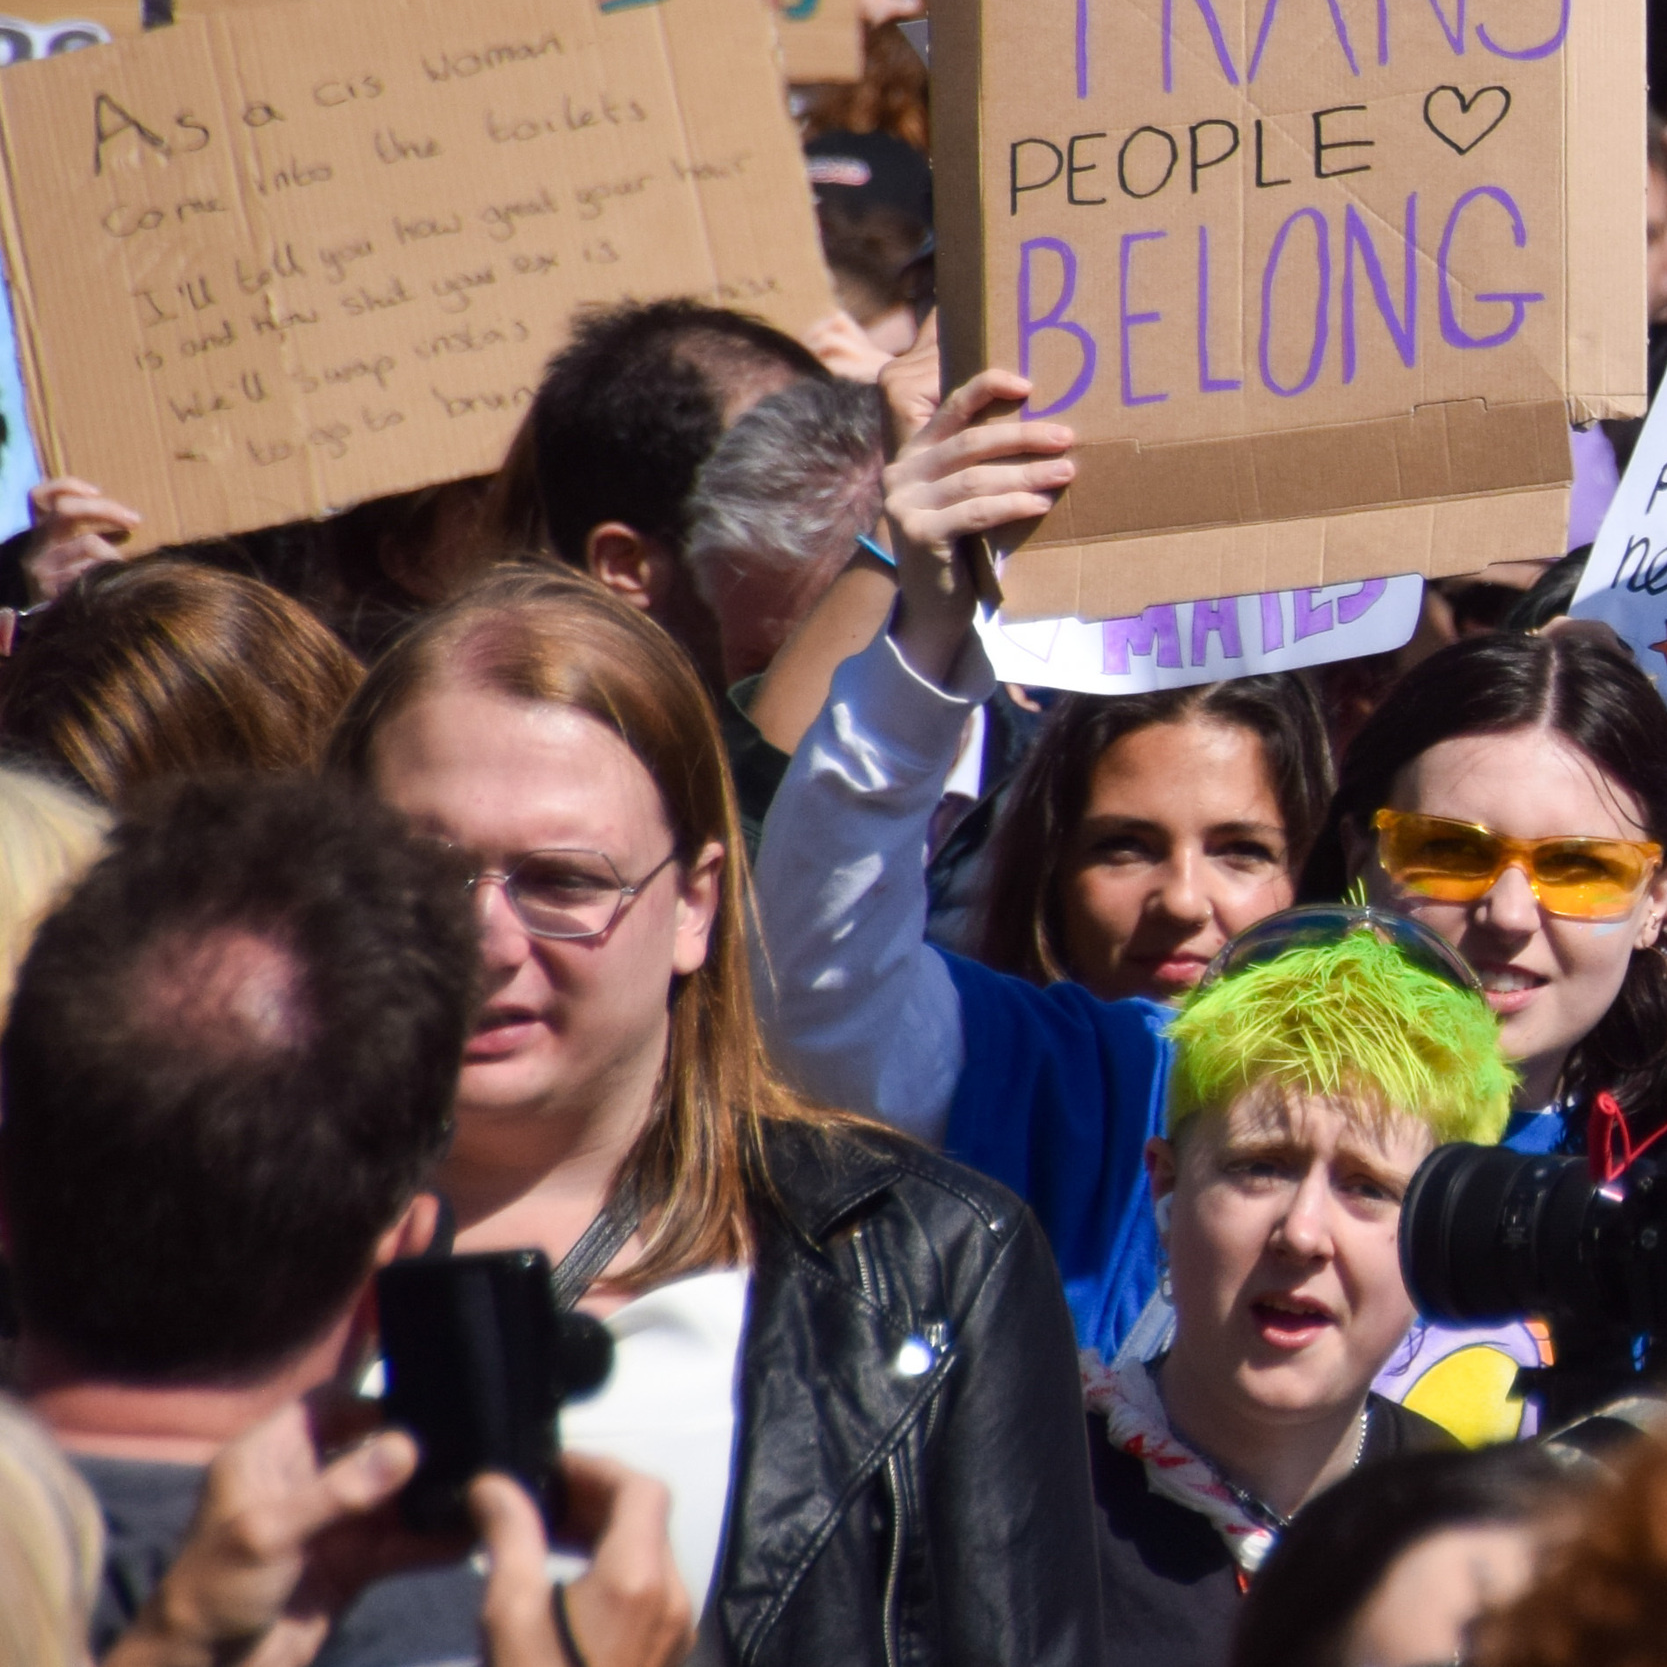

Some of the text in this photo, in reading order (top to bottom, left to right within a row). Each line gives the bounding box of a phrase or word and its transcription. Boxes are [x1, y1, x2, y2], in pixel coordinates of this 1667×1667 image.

[94, 91, 211, 177] As
[243, 100, 286, 128] a
[313, 74, 385, 108] cis
[256, 163, 334, 196] into
[373, 127, 442, 165] the
[484, 92, 649, 145] toilets
[1010, 104, 1376, 217] PEOPLE
[235, 242, 305, 295] tell
[319, 240, 374, 285] you
[1015, 183, 1545, 423] BELONG
[179, 319, 238, 359] and
